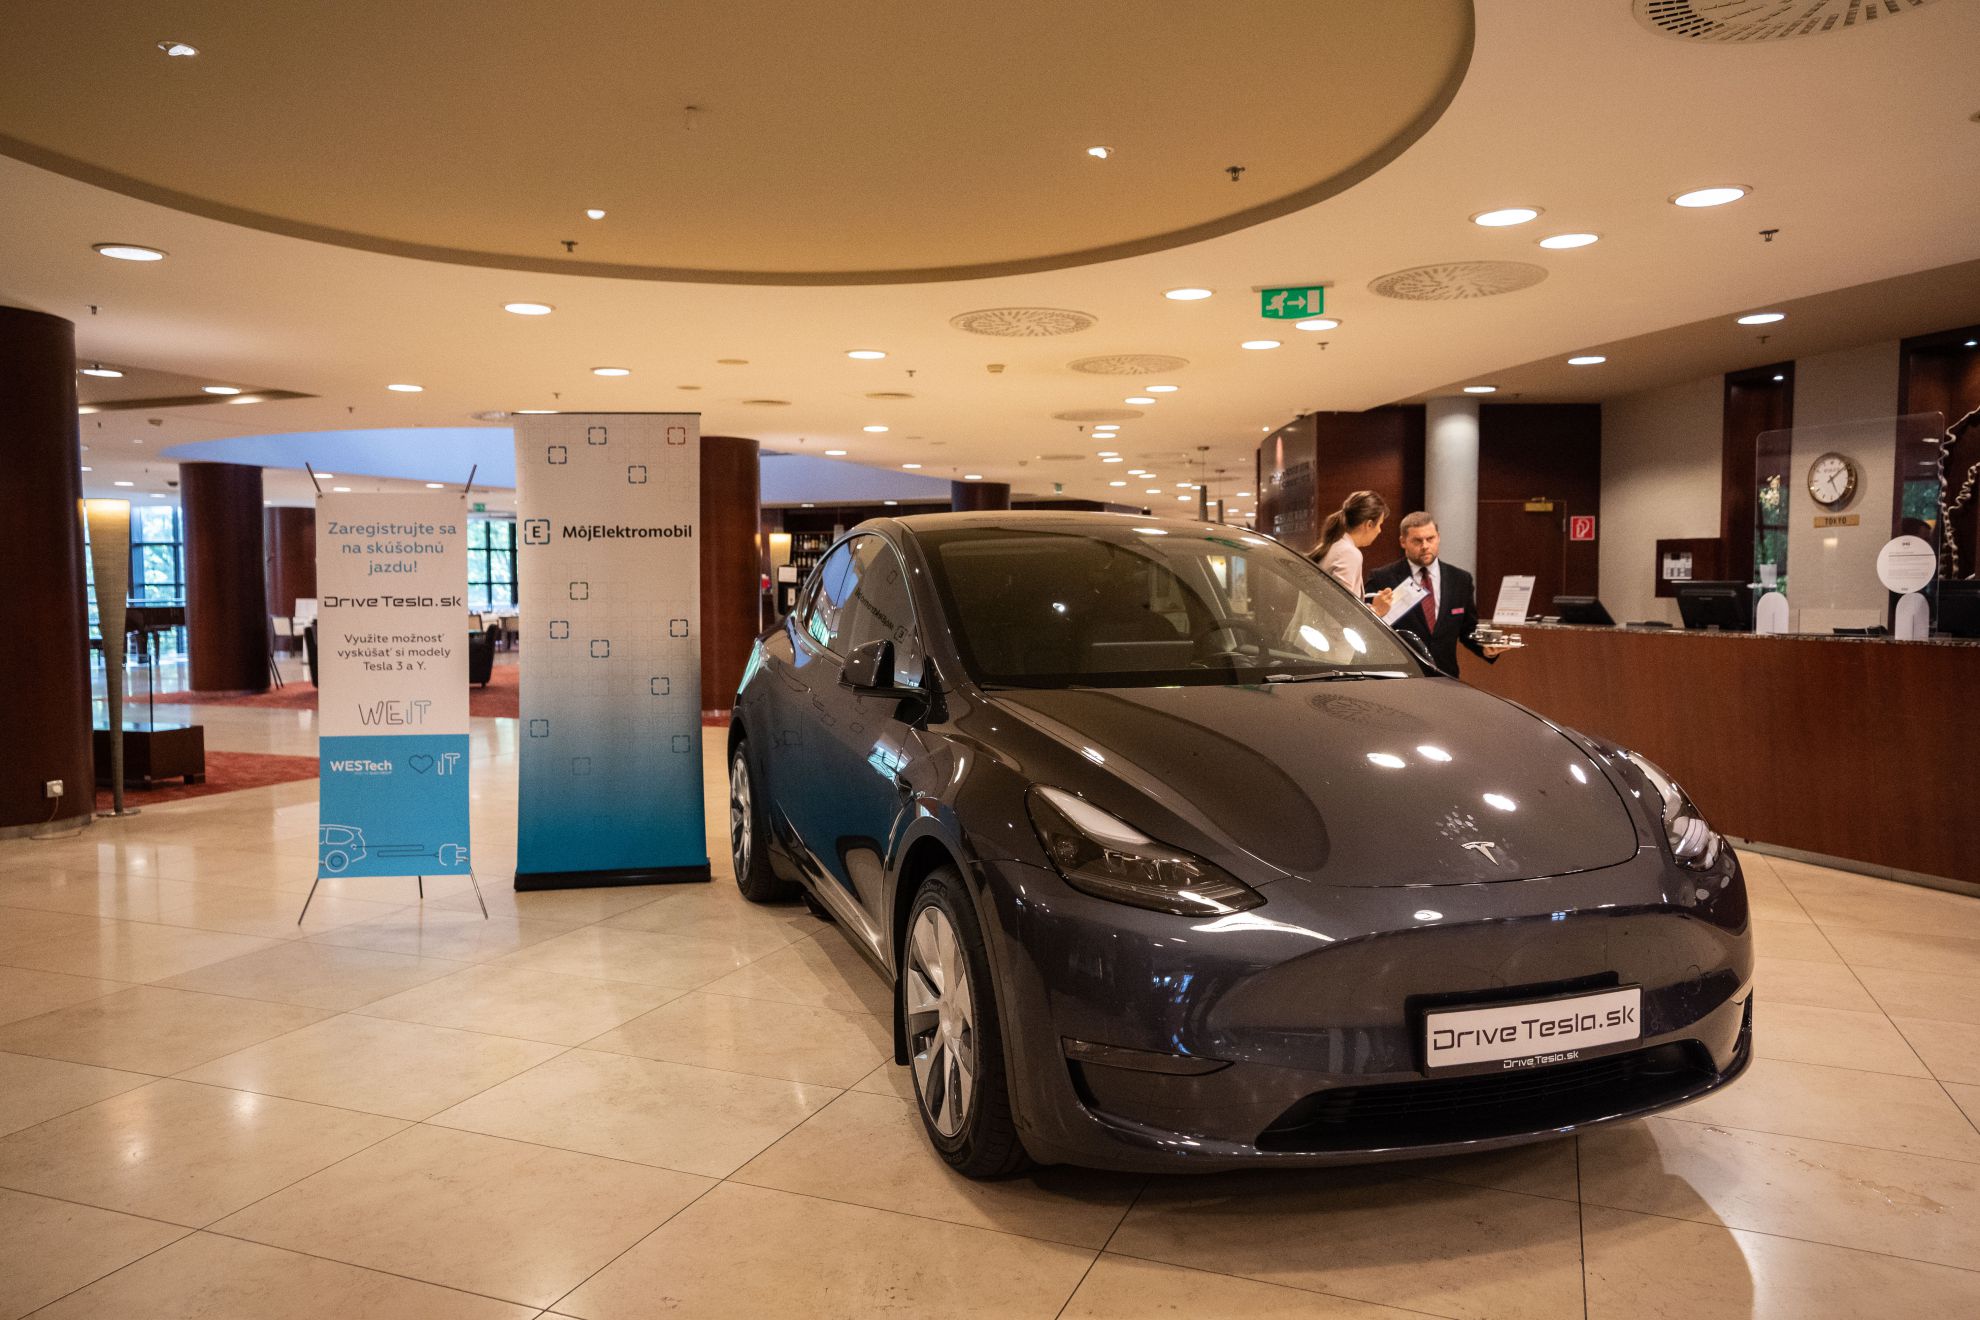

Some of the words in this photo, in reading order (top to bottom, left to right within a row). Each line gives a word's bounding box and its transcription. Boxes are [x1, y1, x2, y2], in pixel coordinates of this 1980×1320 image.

[1825, 516, 1847, 525] TOKYO
[328, 522, 434, 536] Zaregistrujte
[439, 525, 456, 535] sa
[562, 525, 692, 542] MôjElektromobil
[342, 543, 361, 553] na
[367, 540, 444, 554] skúšobnú
[368, 560, 418, 576] jazdu!
[344, 634, 388, 645] Využite
[392, 633, 444, 643] možnosť
[338, 647, 393, 658] vyskúšať
[396, 647, 405, 657] si
[408, 646, 451, 659] modely
[363, 660, 393, 671] Tesla
[396, 661, 403, 671] 3
[406, 663, 414, 671] a
[417, 660, 426, 670] Y.
[330, 760, 392, 772] WESTech
